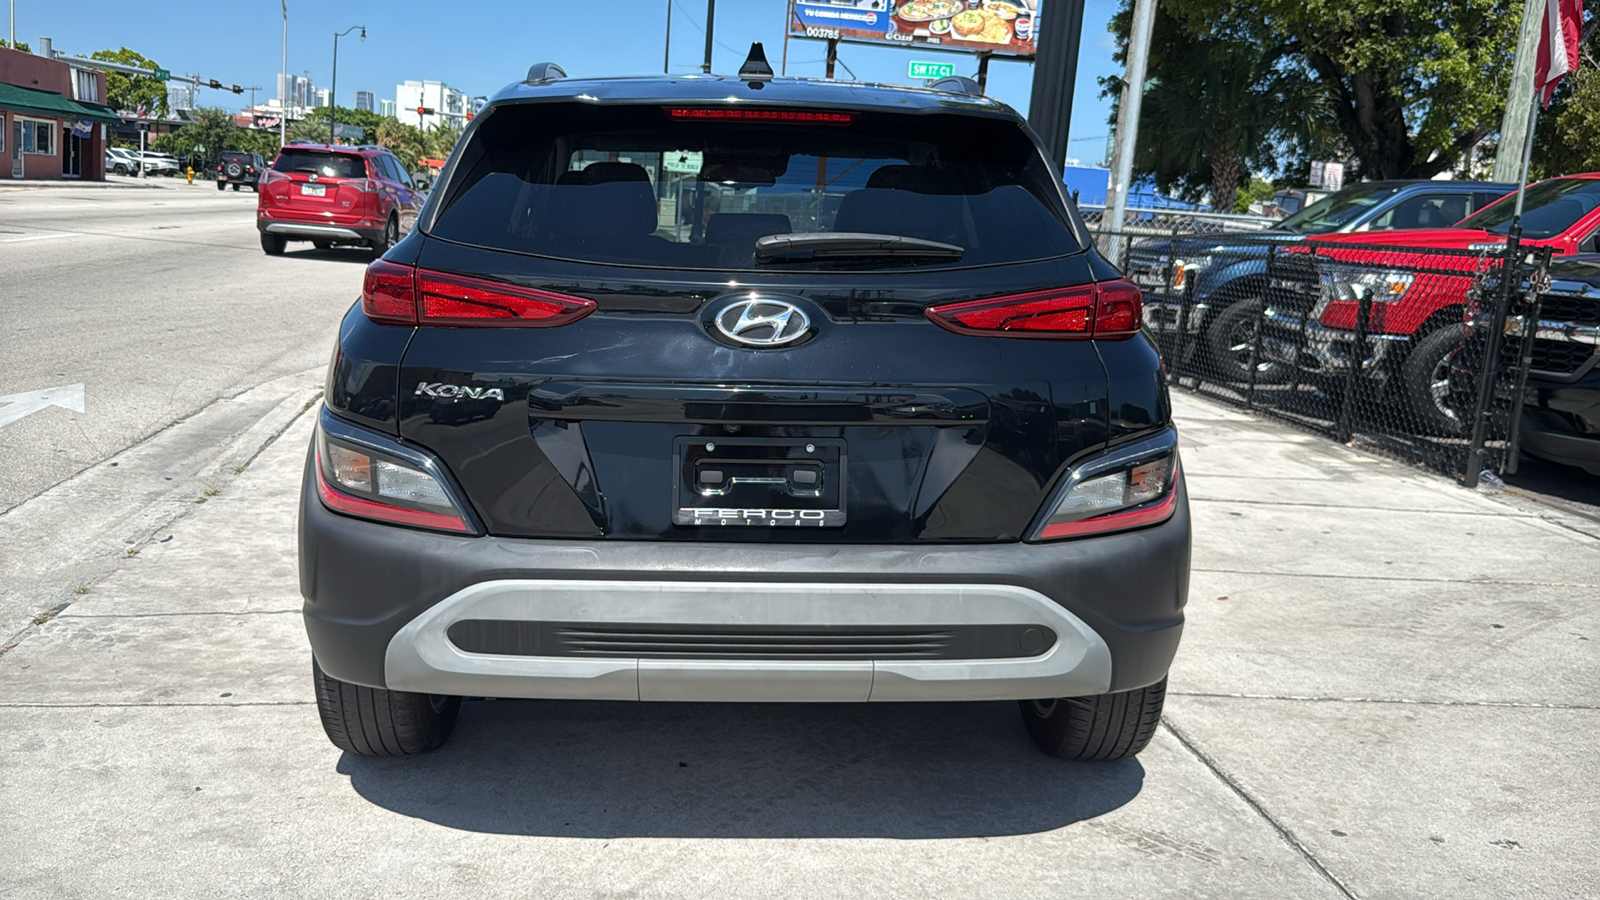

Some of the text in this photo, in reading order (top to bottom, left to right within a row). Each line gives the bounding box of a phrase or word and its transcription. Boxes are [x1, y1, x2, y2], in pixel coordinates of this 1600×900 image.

[806, 27, 840, 39] 003785
[913, 64, 927, 75] SW
[929, 65, 939, 75] 17
[415, 381, 504, 401] KONA
[694, 508, 825, 519] FERCO
